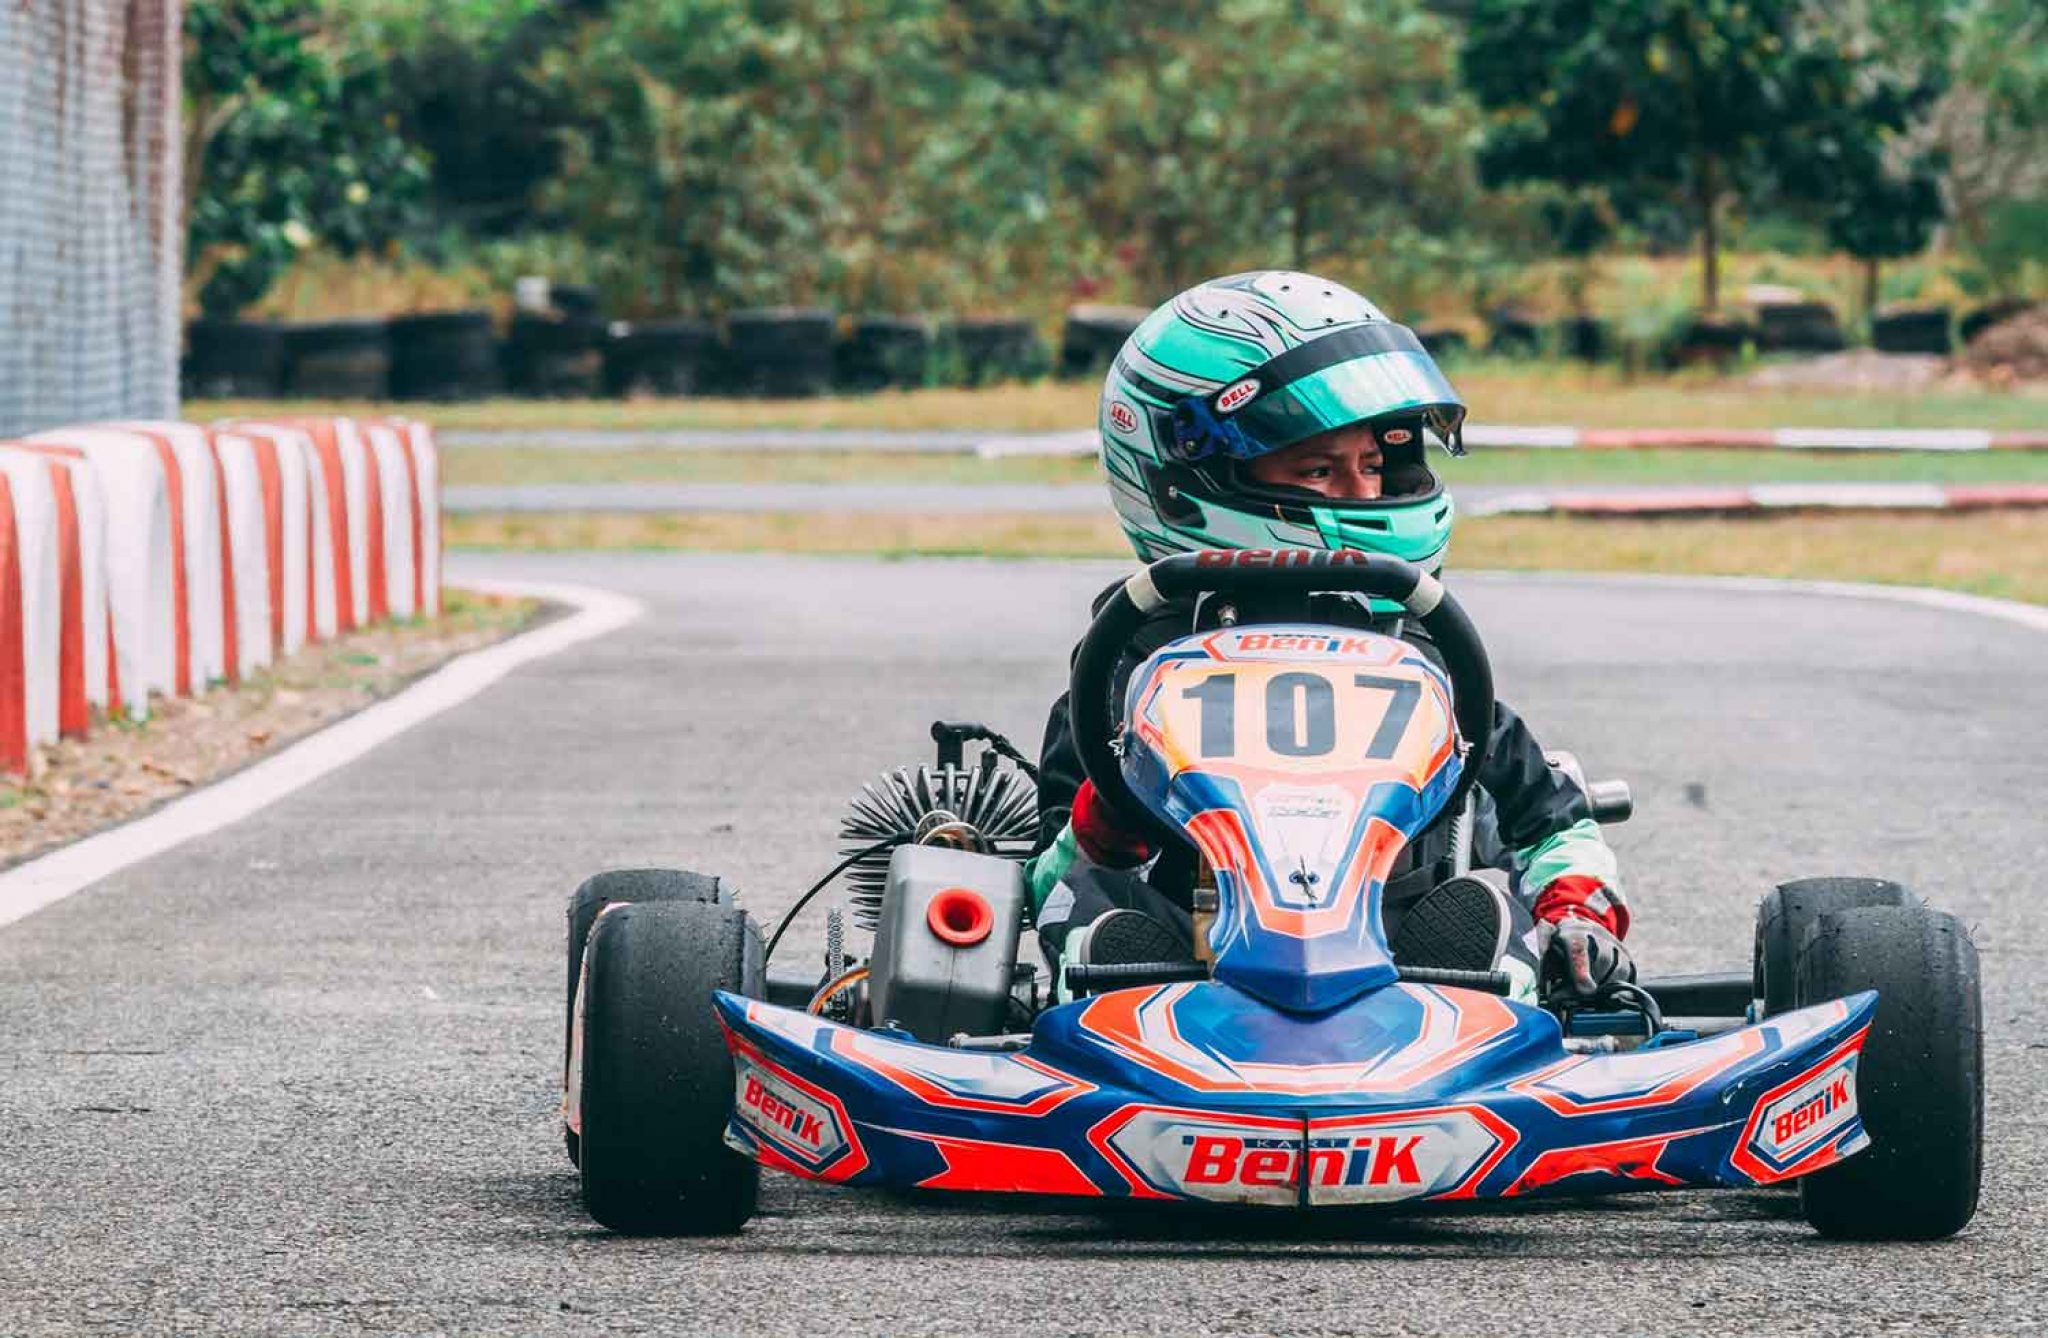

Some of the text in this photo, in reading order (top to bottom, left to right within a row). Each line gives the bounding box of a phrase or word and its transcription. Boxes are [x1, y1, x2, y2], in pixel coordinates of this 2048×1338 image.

[1111, 405, 1133, 427] BELL
[1221, 384, 1254, 407] BELL
[1182, 672, 1422, 760] 107
[744, 1073, 825, 1146] BeniK
[1774, 1074, 1848, 1145] BeniK
[1184, 1135, 1424, 1185] BeniK
[1257, 1139, 1335, 1149] KART
